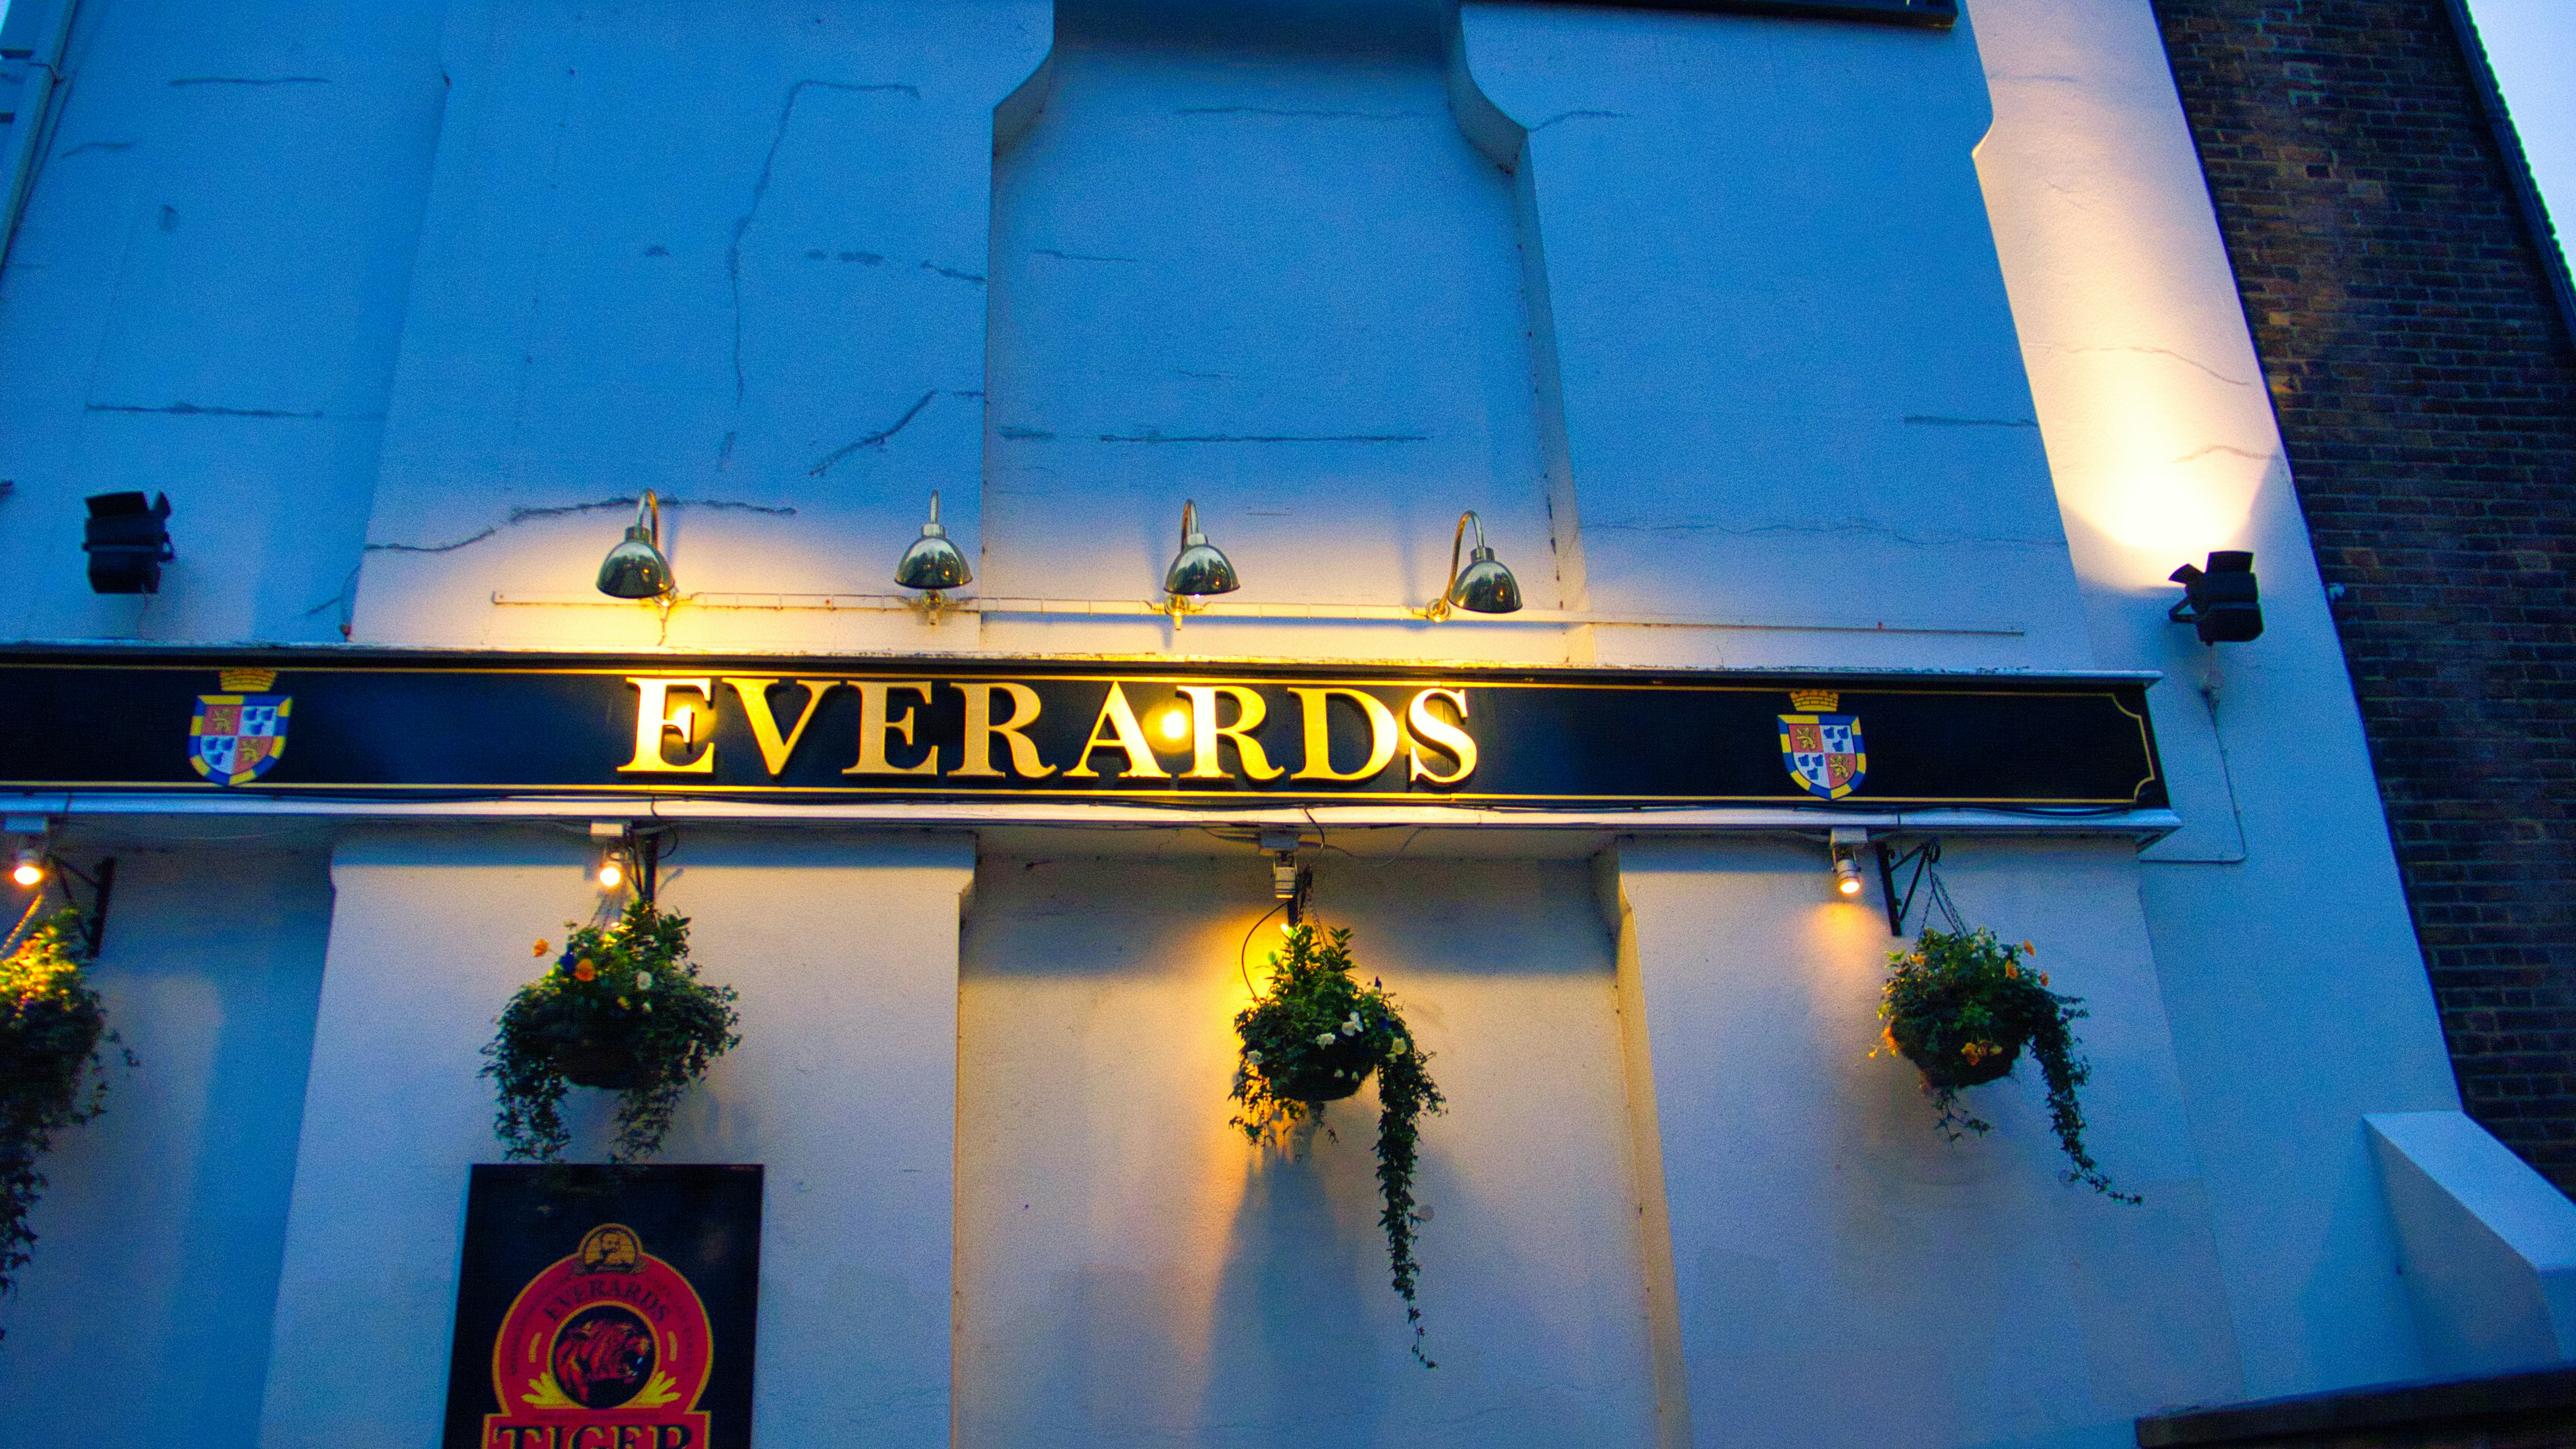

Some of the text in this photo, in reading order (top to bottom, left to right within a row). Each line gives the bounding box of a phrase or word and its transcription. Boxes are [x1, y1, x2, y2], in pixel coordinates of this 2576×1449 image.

[617, 676, 1478, 785] EVERARDS
[543, 1279, 667, 1322] EVERARDS
[492, 1424, 692, 1449] TIGER
